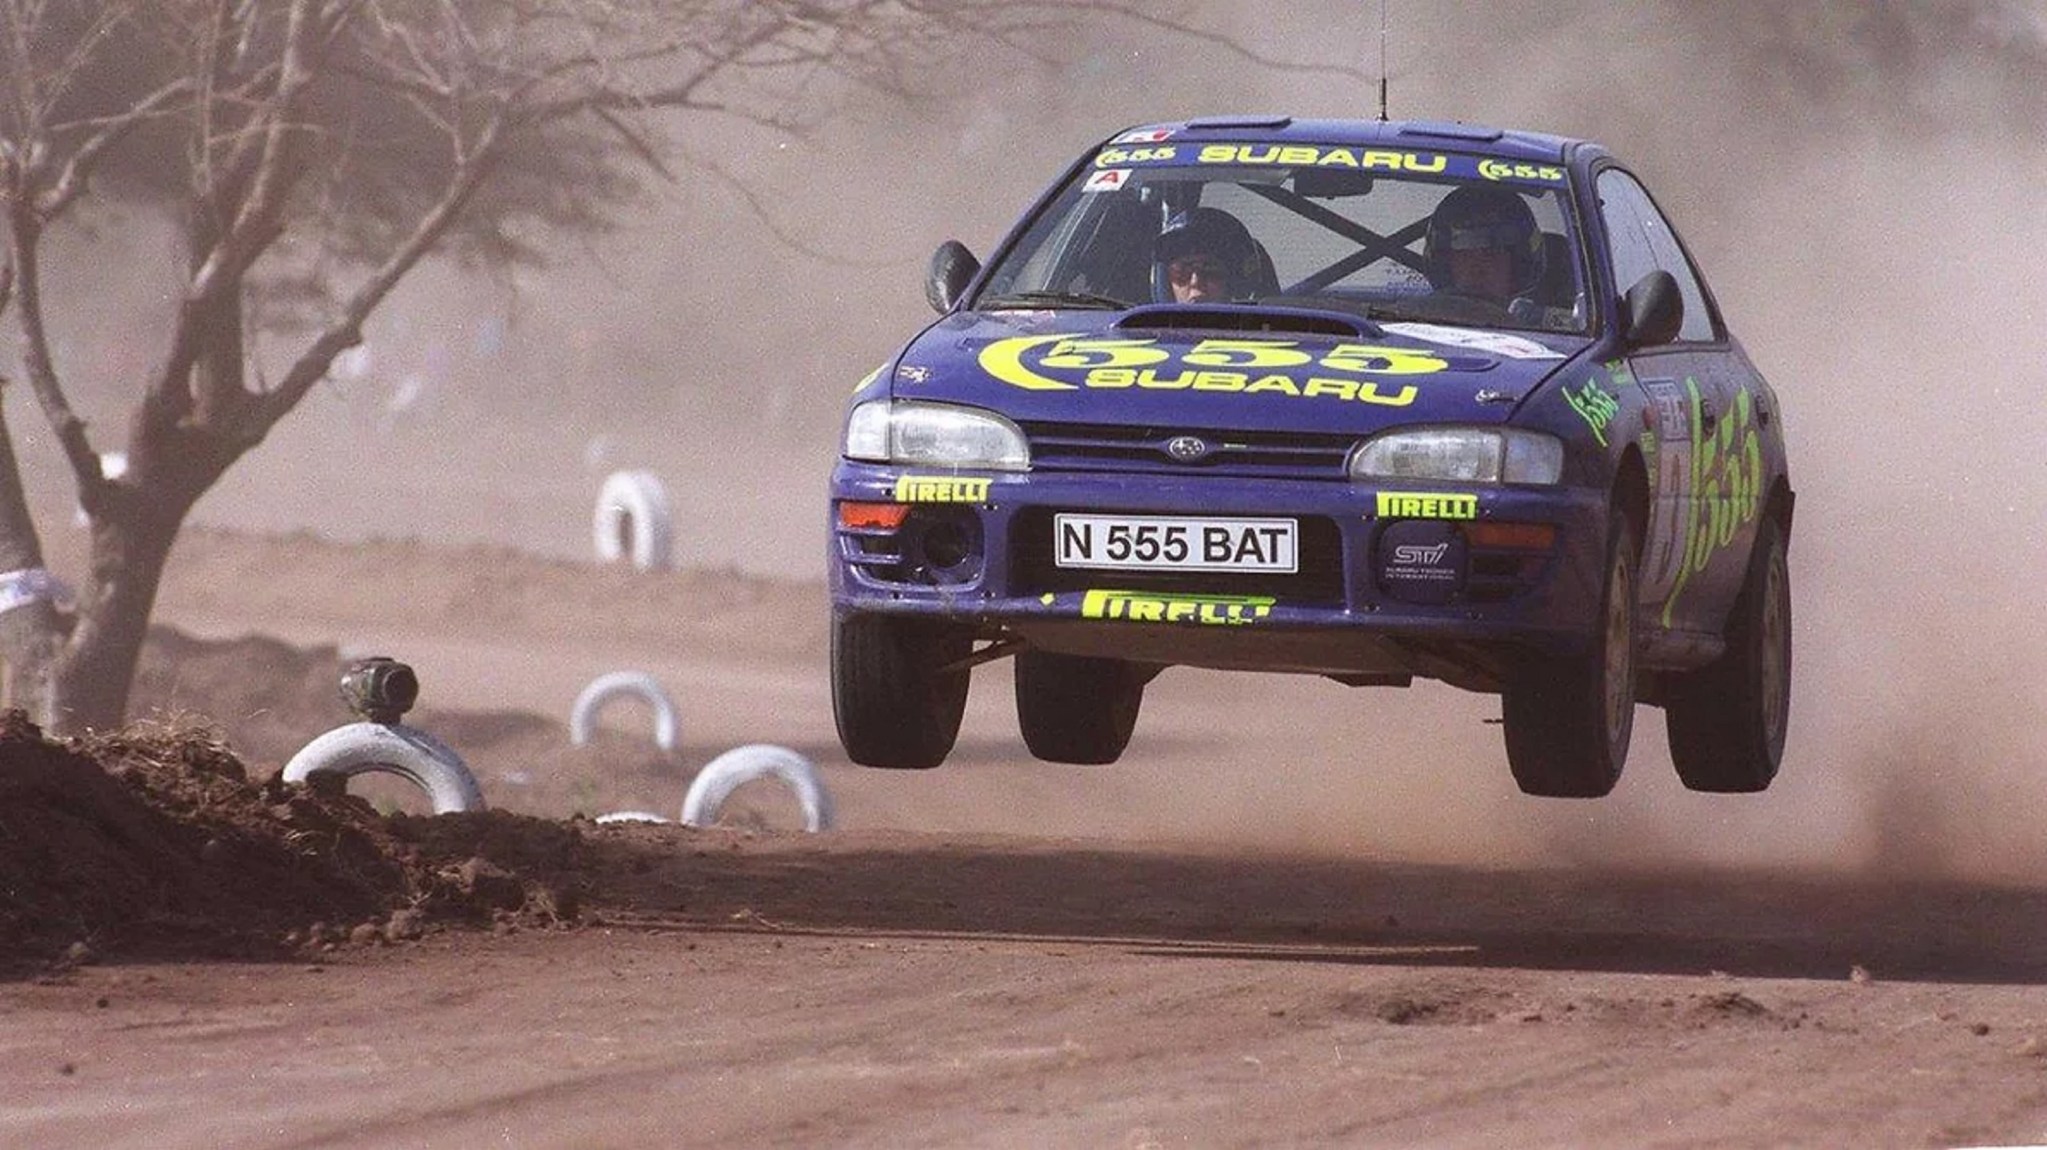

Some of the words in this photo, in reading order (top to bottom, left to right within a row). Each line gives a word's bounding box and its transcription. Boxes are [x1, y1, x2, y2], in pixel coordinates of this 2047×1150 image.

[1198, 144, 1447, 173] SUBARU
[1488, 163, 1562, 181] 555
[1095, 171, 1119, 184] A
[1038, 338, 1449, 375] 555
[1085, 368, 1418, 406] SUBARU
[896, 475, 993, 502] PIRELLI
[1376, 491, 1478, 519] PIRELLI
[1063, 523, 1092, 560] N
[1106, 525, 1188, 563] 555
[1203, 526, 1288, 564] BAT
